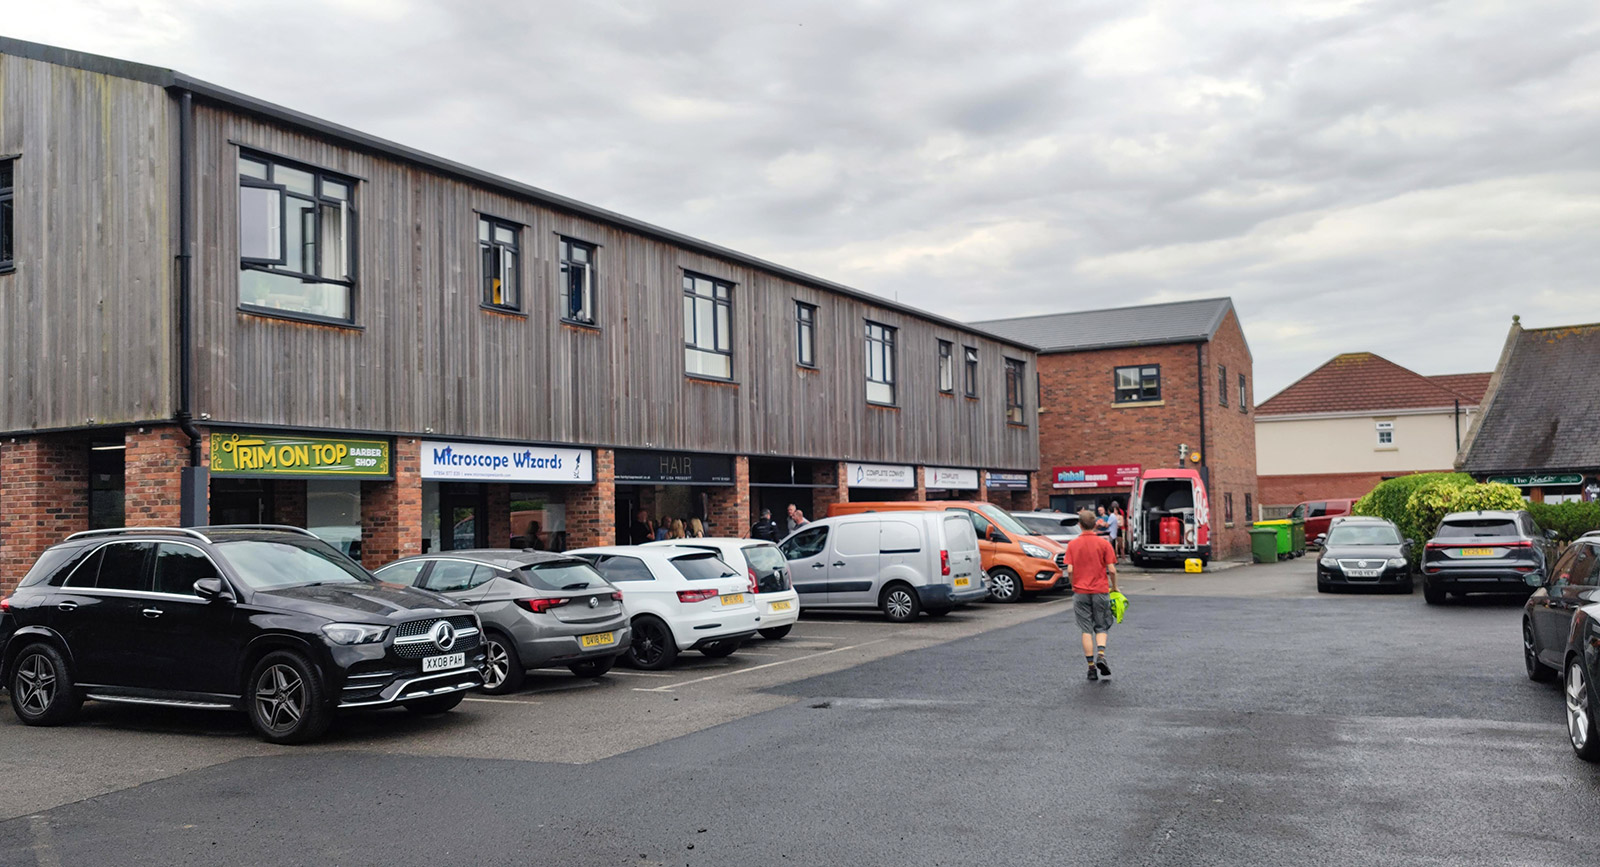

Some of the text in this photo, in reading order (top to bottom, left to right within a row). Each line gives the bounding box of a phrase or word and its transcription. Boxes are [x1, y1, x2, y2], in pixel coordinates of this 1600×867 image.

[222, 434, 348, 469] TRIM ON TOP
[350, 447, 382, 457] BARBER
[433, 445, 563, 470] Microscope Wizards
[355, 458, 377, 467] SHOP
[660, 456, 692, 474] HAIR
[585, 633, 611, 646] DV18 PFO
[426, 655, 463, 669] XX08 PAH
